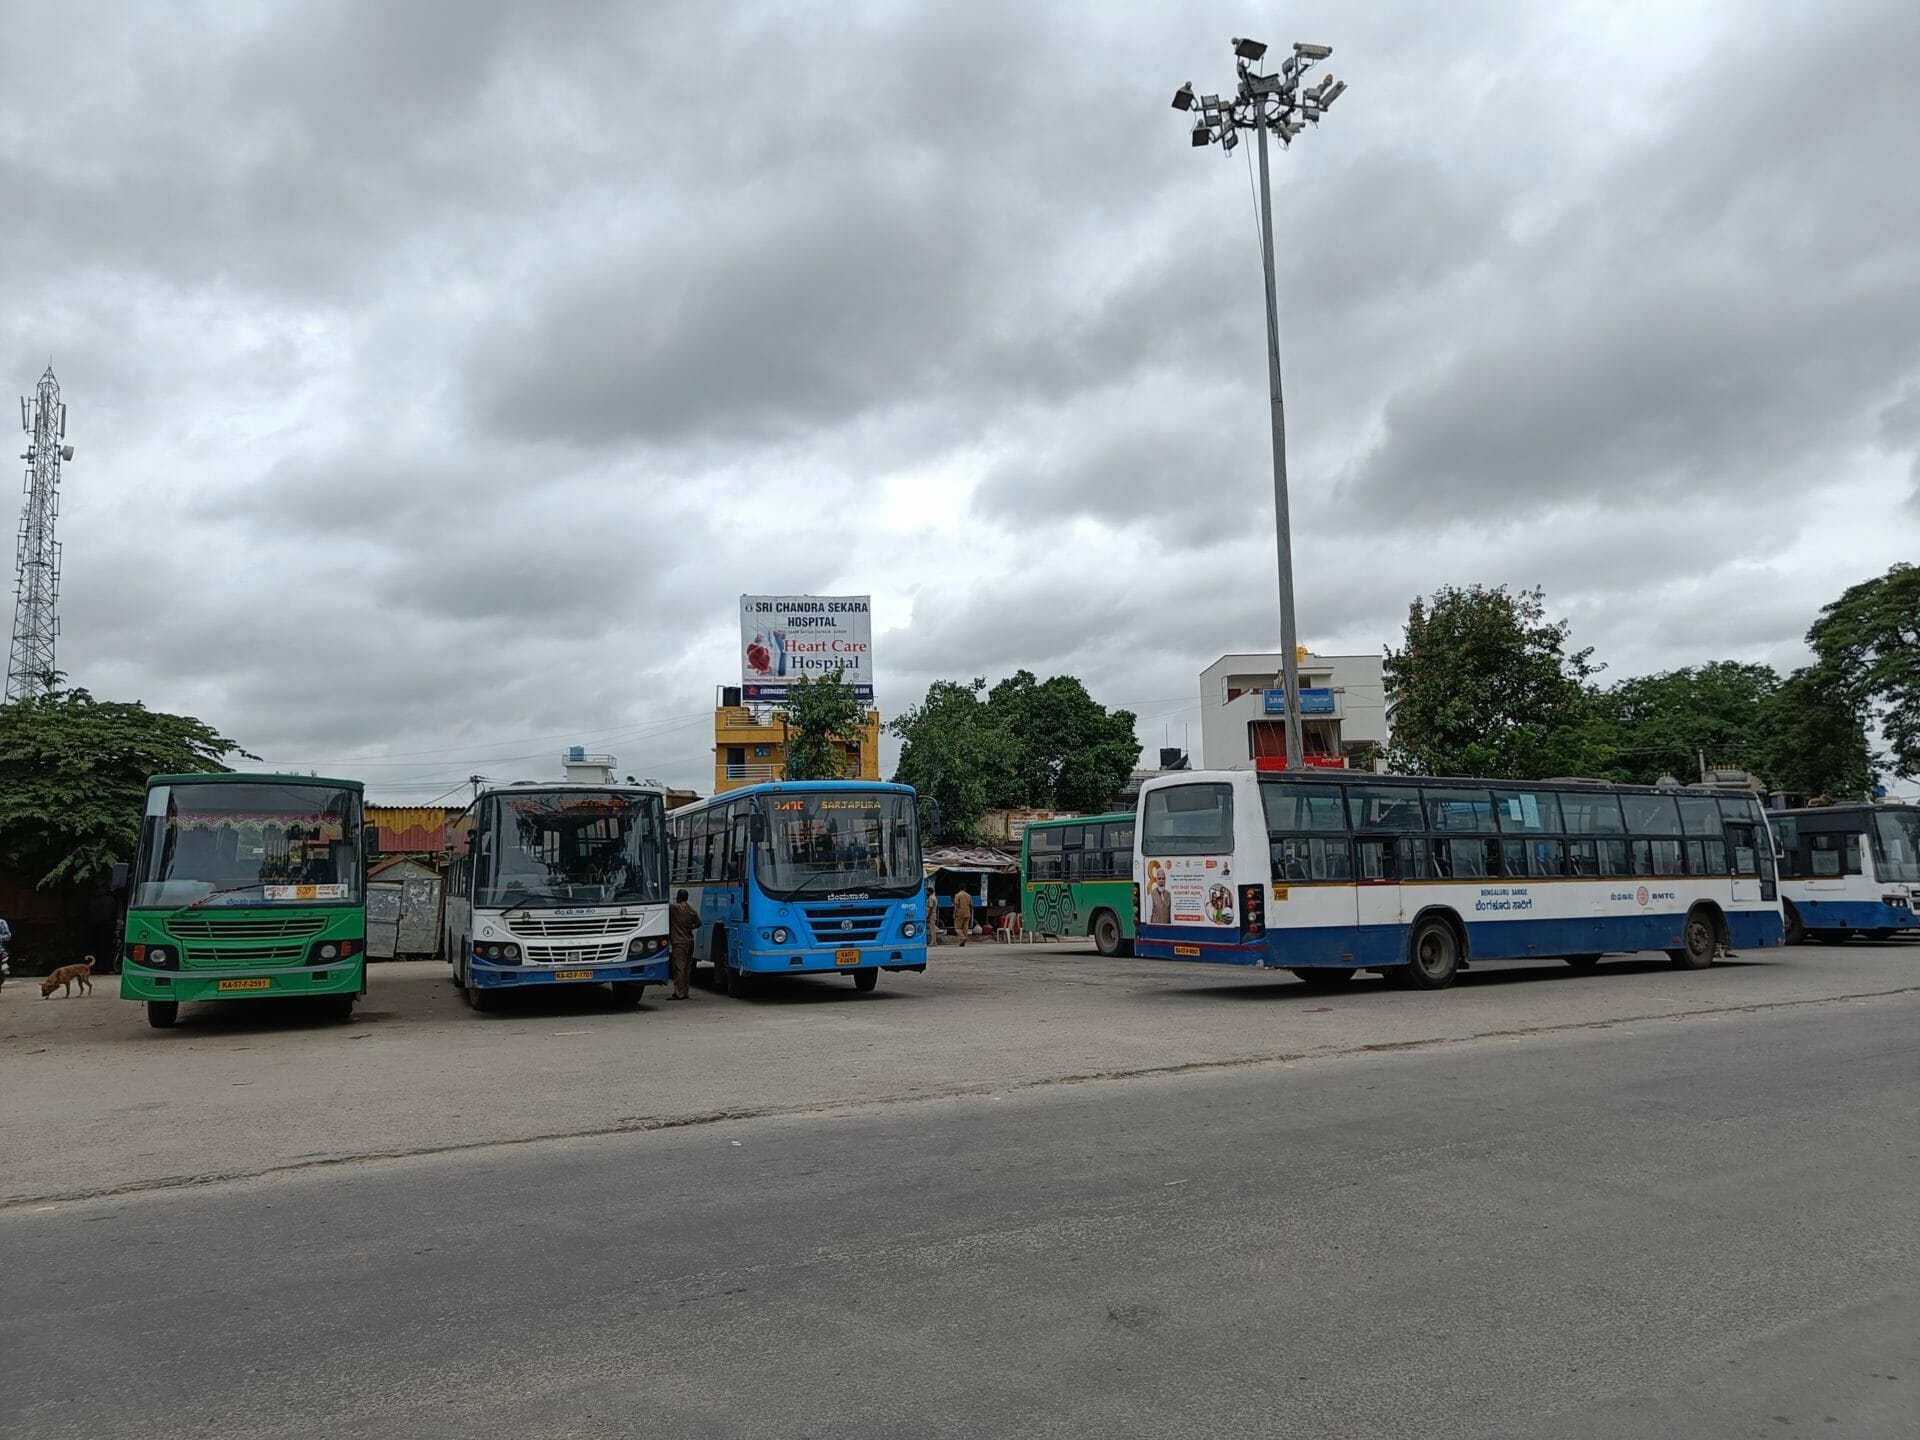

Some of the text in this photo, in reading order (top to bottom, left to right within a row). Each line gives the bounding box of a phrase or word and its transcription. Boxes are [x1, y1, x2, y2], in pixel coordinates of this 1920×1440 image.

[755, 602, 868, 613] SRI CHANDRA SEKARA
[787, 616, 837, 627] HOSPITAL
[784, 639, 867, 652] Heart Care
[1480, 888, 1528, 896] BENGALURU SARIGE
[1651, 892, 1675, 900] BMTC
